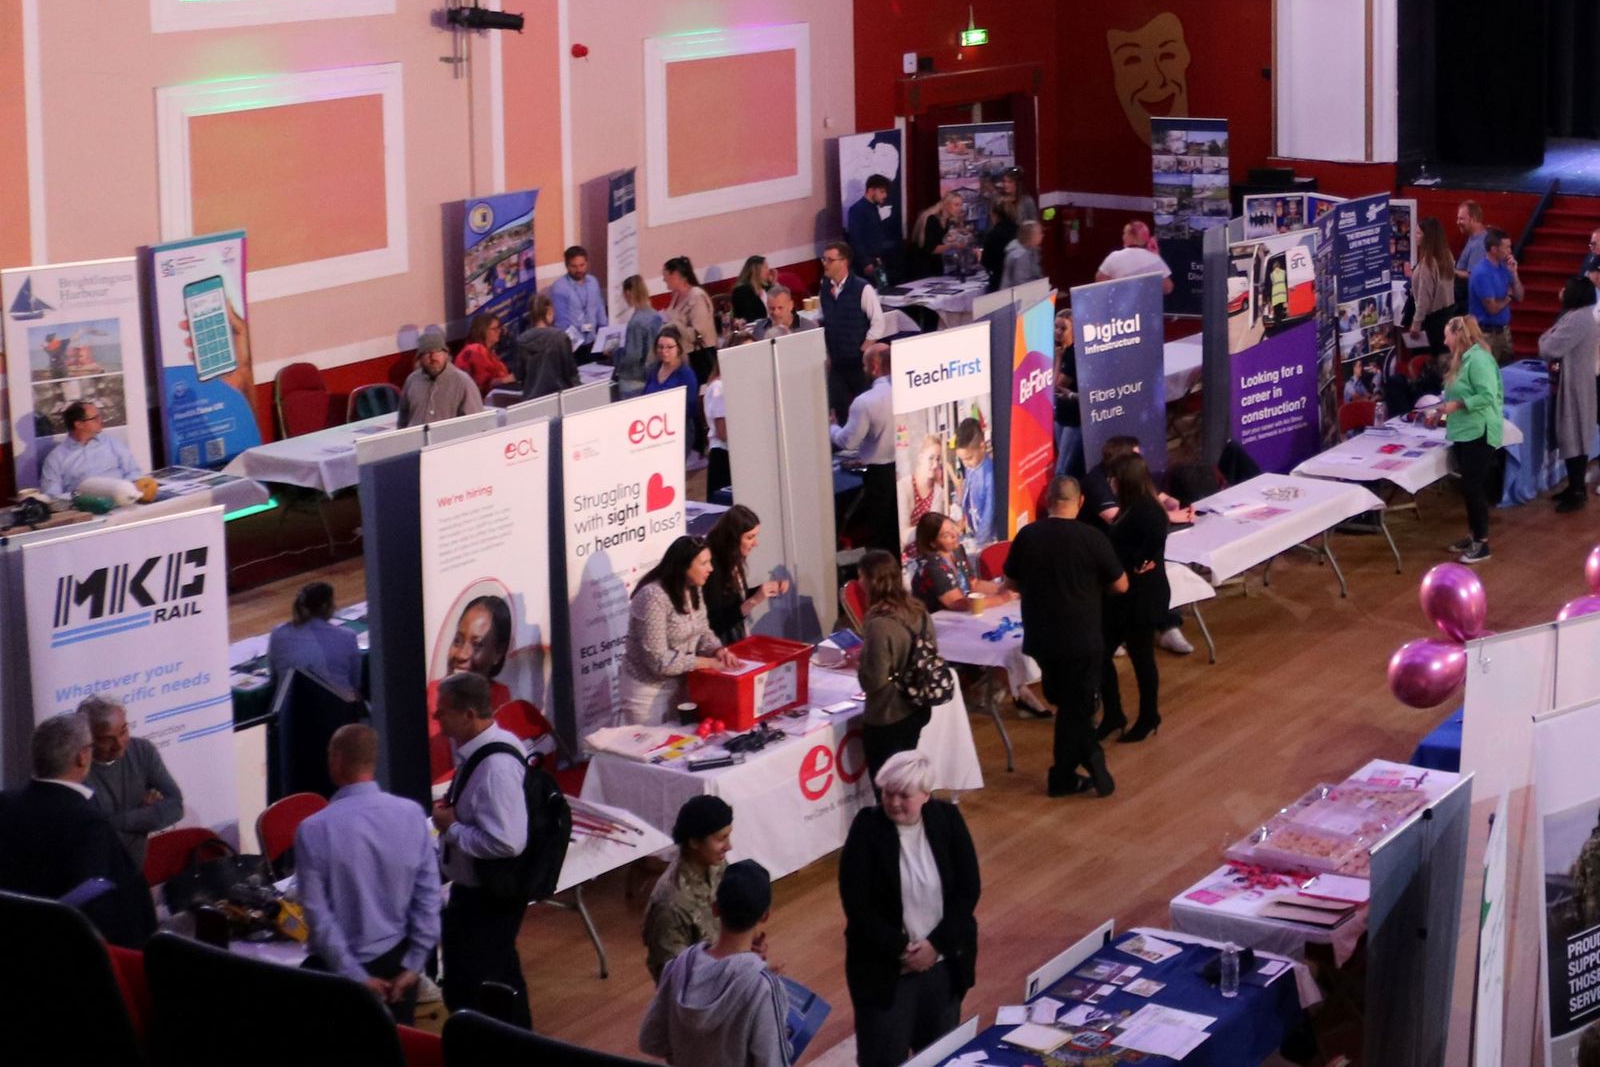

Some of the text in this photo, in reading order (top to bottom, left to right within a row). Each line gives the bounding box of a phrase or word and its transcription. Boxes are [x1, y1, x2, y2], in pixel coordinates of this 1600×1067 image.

[1082, 313, 1140, 342] Digital
[1241, 364, 1303, 389] Looking for a
[1089, 381, 1143, 404] Fibre your
[1241, 386, 1282, 407] career in
[1241, 396, 1307, 425] construction?
[437, 485, 493, 508] We're hiring
[573, 482, 641, 513] Struggling
[574, 503, 640, 535] with sight
[576, 511, 682, 558] or hearing loss?
[53, 546, 208, 628] MKC
[154, 601, 202, 624] RAIL
[55, 660, 184, 703] Whatever your
[161, 672, 211, 694] needs
